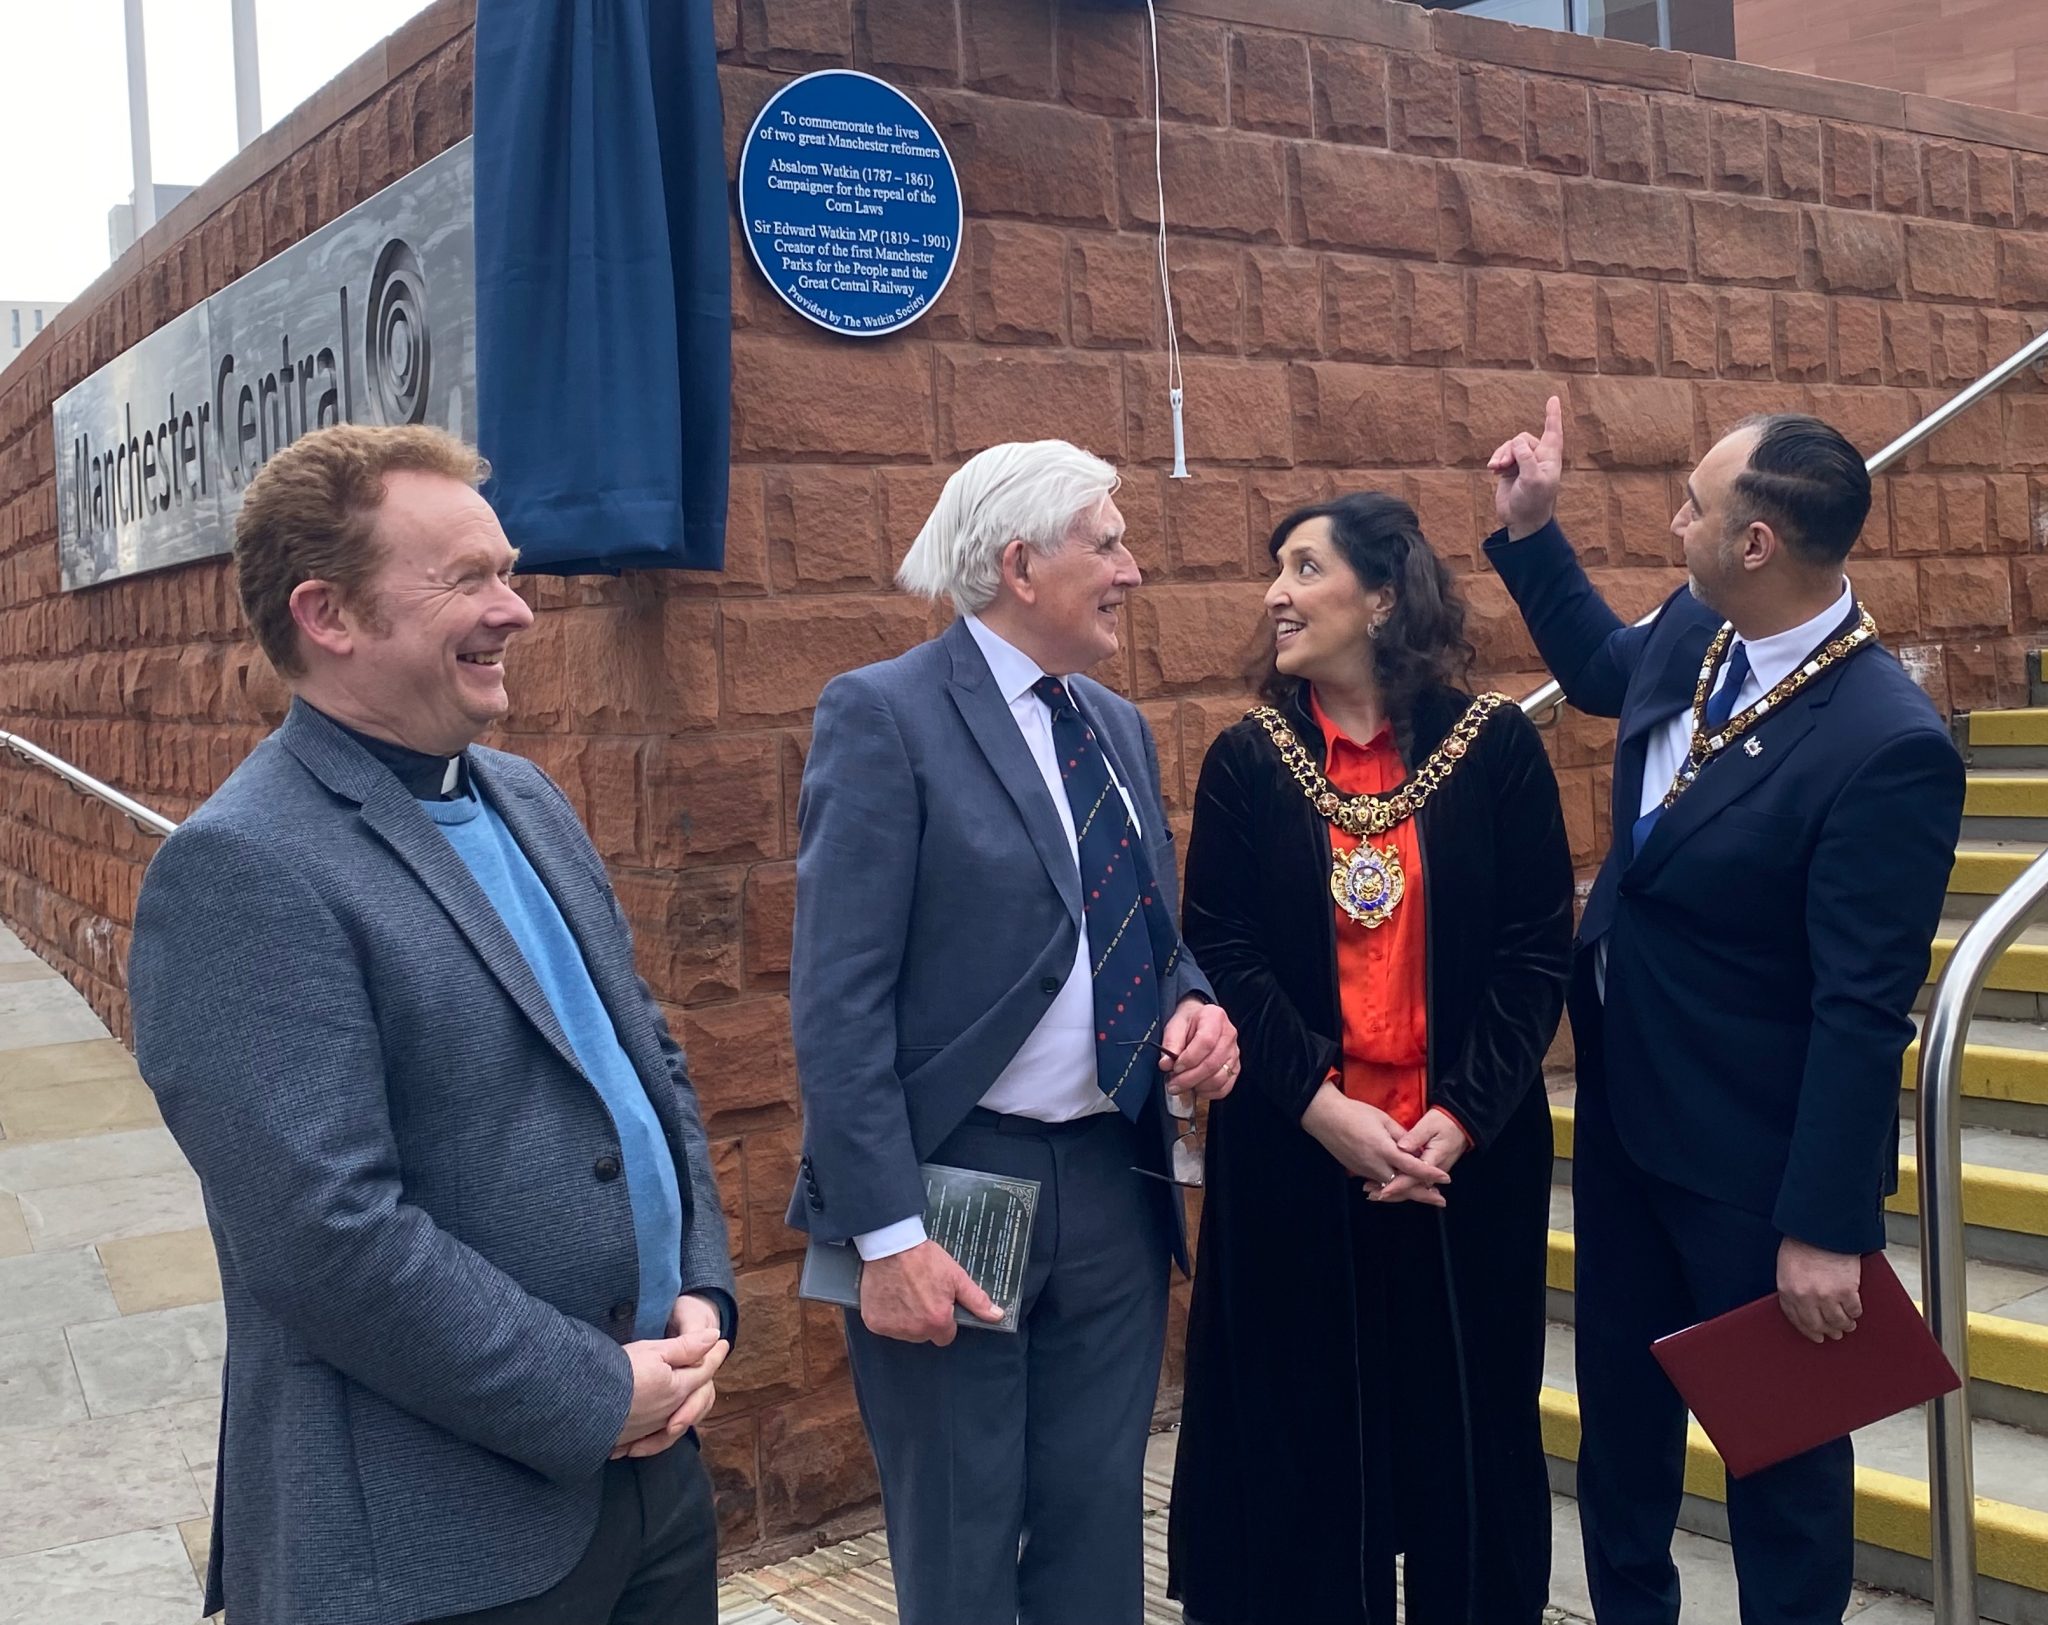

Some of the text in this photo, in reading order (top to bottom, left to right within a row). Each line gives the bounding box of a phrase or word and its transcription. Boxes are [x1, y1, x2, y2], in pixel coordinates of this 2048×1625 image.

[781, 111, 919, 140] To commemorate the lives
[760, 127, 940, 158] of two great Manchester reformers
[769, 159, 818, 175] Absalom
[821, 163, 859, 179] Watkin
[862, 167, 892, 183] (1787
[905, 172, 933, 189] 1861)
[768, 176, 936, 204] Campaigner for the repeal of the
[826, 199, 883, 215] Corn Laws
[755, 220, 771, 234] Sir
[774, 222, 816, 238] Edward
[819, 226, 856, 241] Watkin
[859, 229, 878, 242] MP
[880, 231, 909, 245] (1819
[923, 234, 950, 251] 1901)
[774, 239, 934, 263] Creator of the first Manchester
[783, 257, 927, 279] Parks for the People and the
[799, 276, 914, 297] Great Central Railway
[788, 284, 925, 328] Provided by The Watkin Society
[75, 285, 353, 540] Manchester Central
